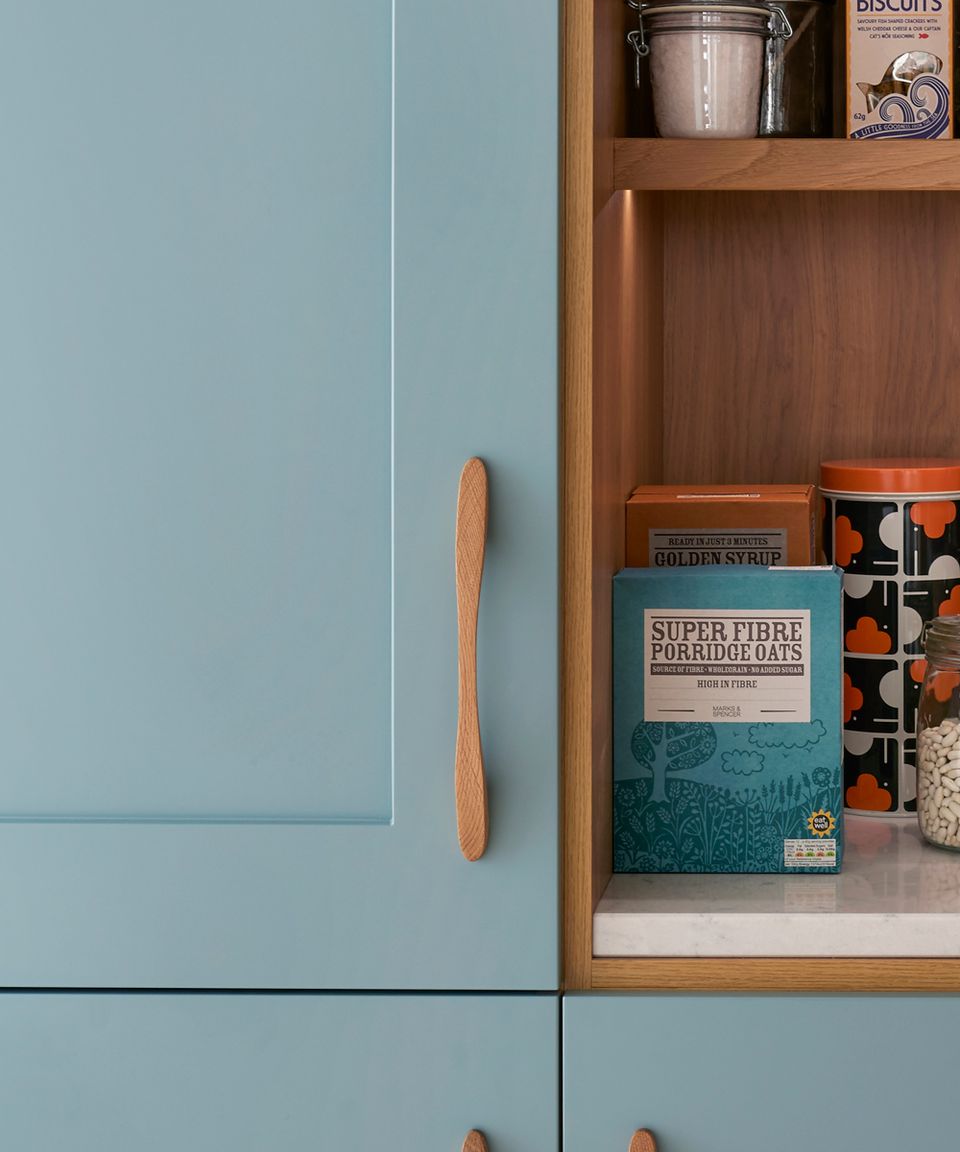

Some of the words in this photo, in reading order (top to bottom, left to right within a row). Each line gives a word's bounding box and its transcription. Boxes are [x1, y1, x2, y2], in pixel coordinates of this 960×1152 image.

[853, 113, 866, 121] 62g
[861, 125, 883, 135] LITTLE
[654, 551, 721, 566] GOLDEN
[725, 551, 782, 566] SYRUP
[651, 621, 728, 642] SUPER
[732, 621, 803, 642] FIBRE
[651, 643, 751, 661] PORRIDGE
[755, 643, 803, 661] OATS
[697, 680, 719, 688] HIGH
[720, 680, 730, 688] IN
[731, 680, 758, 688] FIBRE
